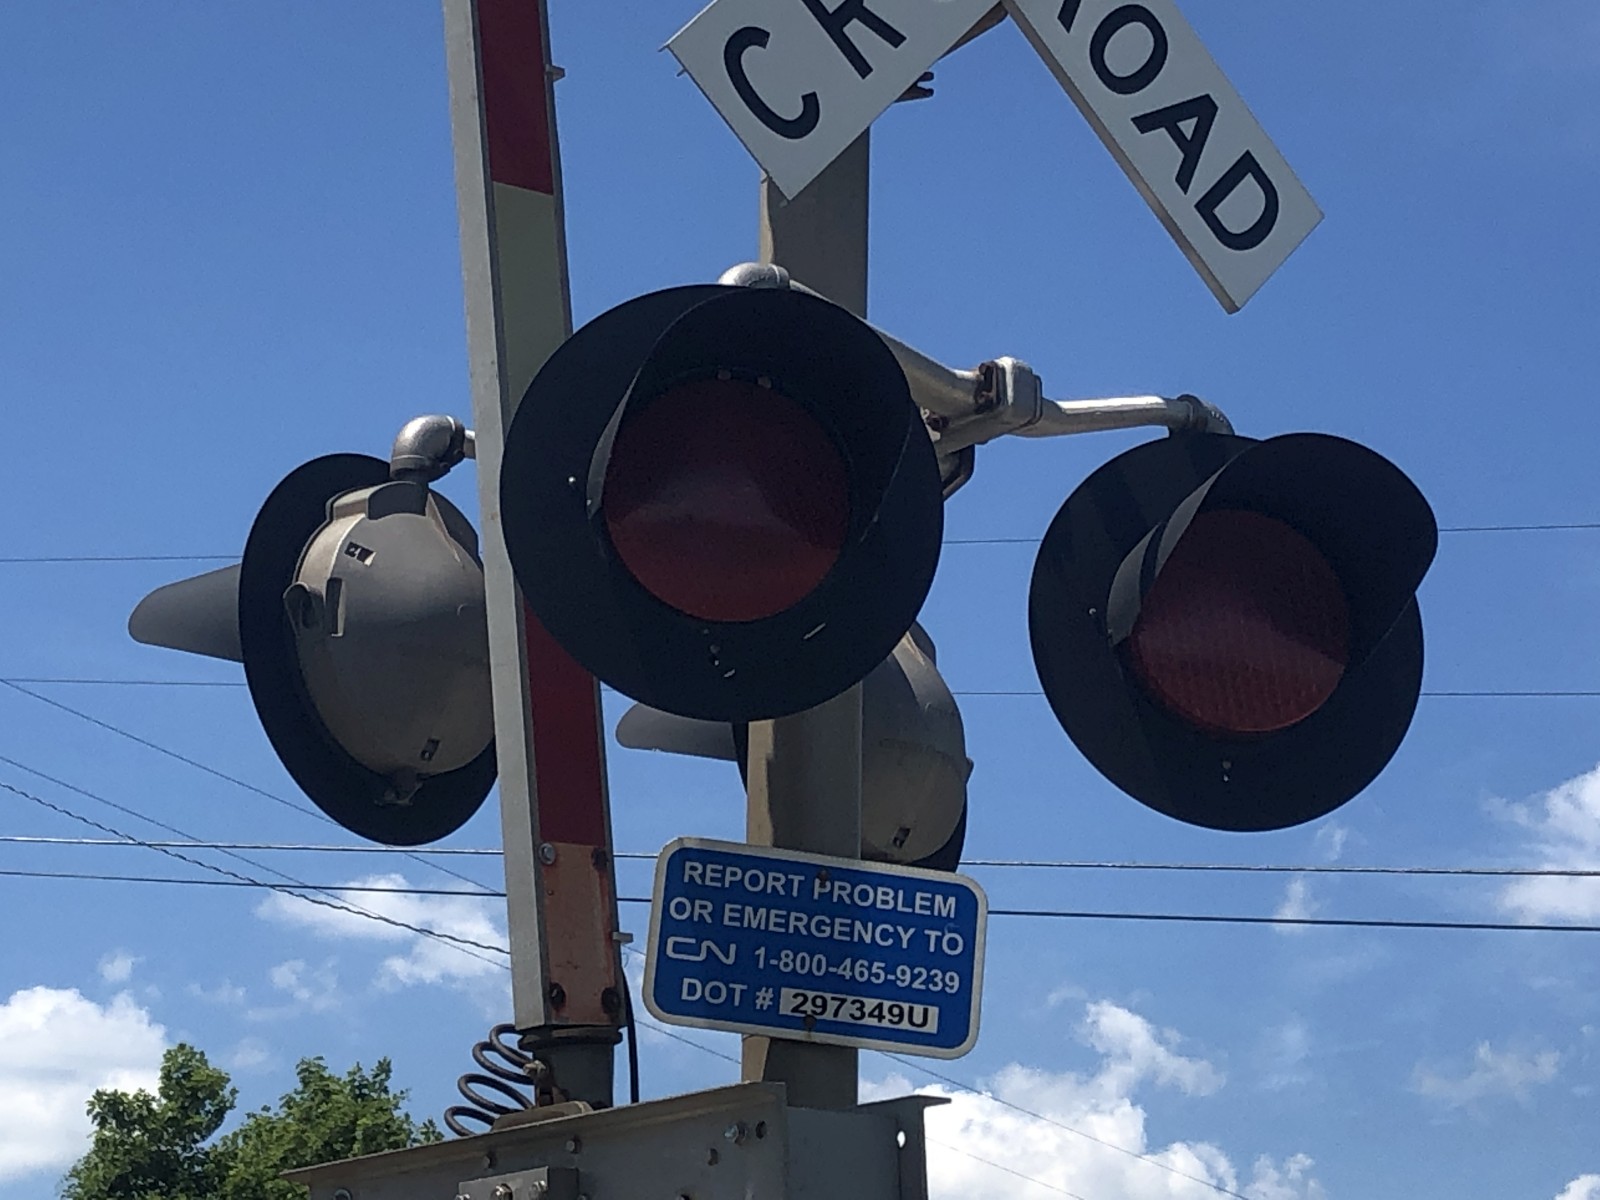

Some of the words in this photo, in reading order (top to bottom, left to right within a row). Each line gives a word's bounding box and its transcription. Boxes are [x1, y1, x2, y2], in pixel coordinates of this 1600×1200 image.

[1056, 0, 1280, 252] OAD
[684, 860, 805, 898] REPORT
[813, 876, 956, 919] PROBLEM
[669, 896, 714, 925] OR
[723, 903, 916, 949] EMERGENCY
[924, 929, 964, 956] TO
[665, 936, 737, 966] CN
[754, 946, 961, 994] 1-800-465-9239
[681, 977, 748, 1007] DOT
[755, 986, 774, 1011] #
[790, 992, 930, 1029] 297349U
